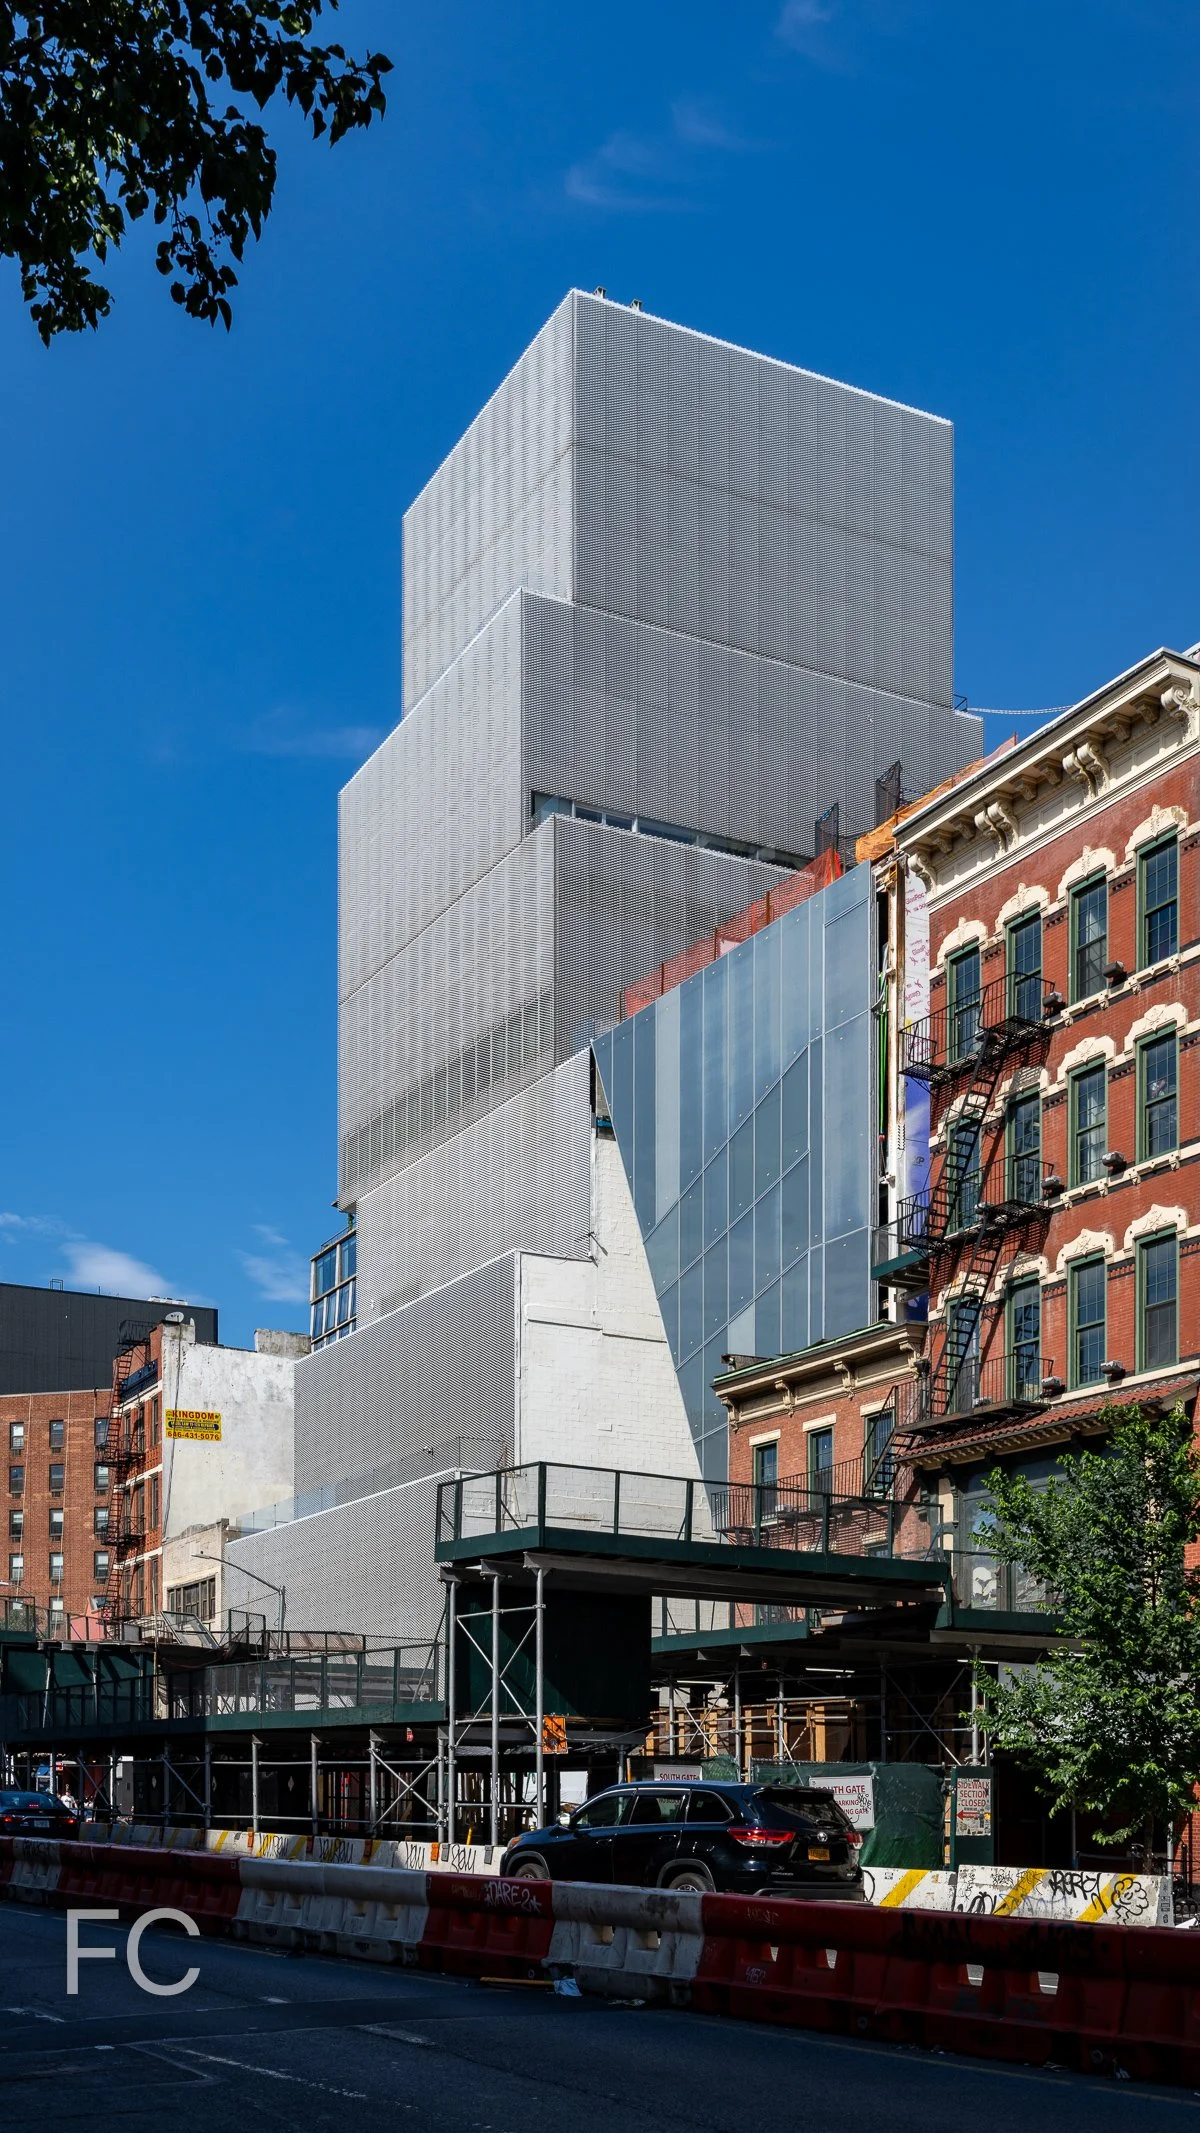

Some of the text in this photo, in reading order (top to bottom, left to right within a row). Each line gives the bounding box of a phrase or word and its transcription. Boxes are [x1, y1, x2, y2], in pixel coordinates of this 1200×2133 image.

[172, 1410, 214, 1420] KINGDOM
[167, 1431, 220, 1441] 646-431-5076
[957, 1781, 990, 1789] SIDEWALK
[846, 1785, 866, 1794] GATE
[960, 1790, 987, 1798] SECTION
[961, 1799, 987, 1807] CLOSED
